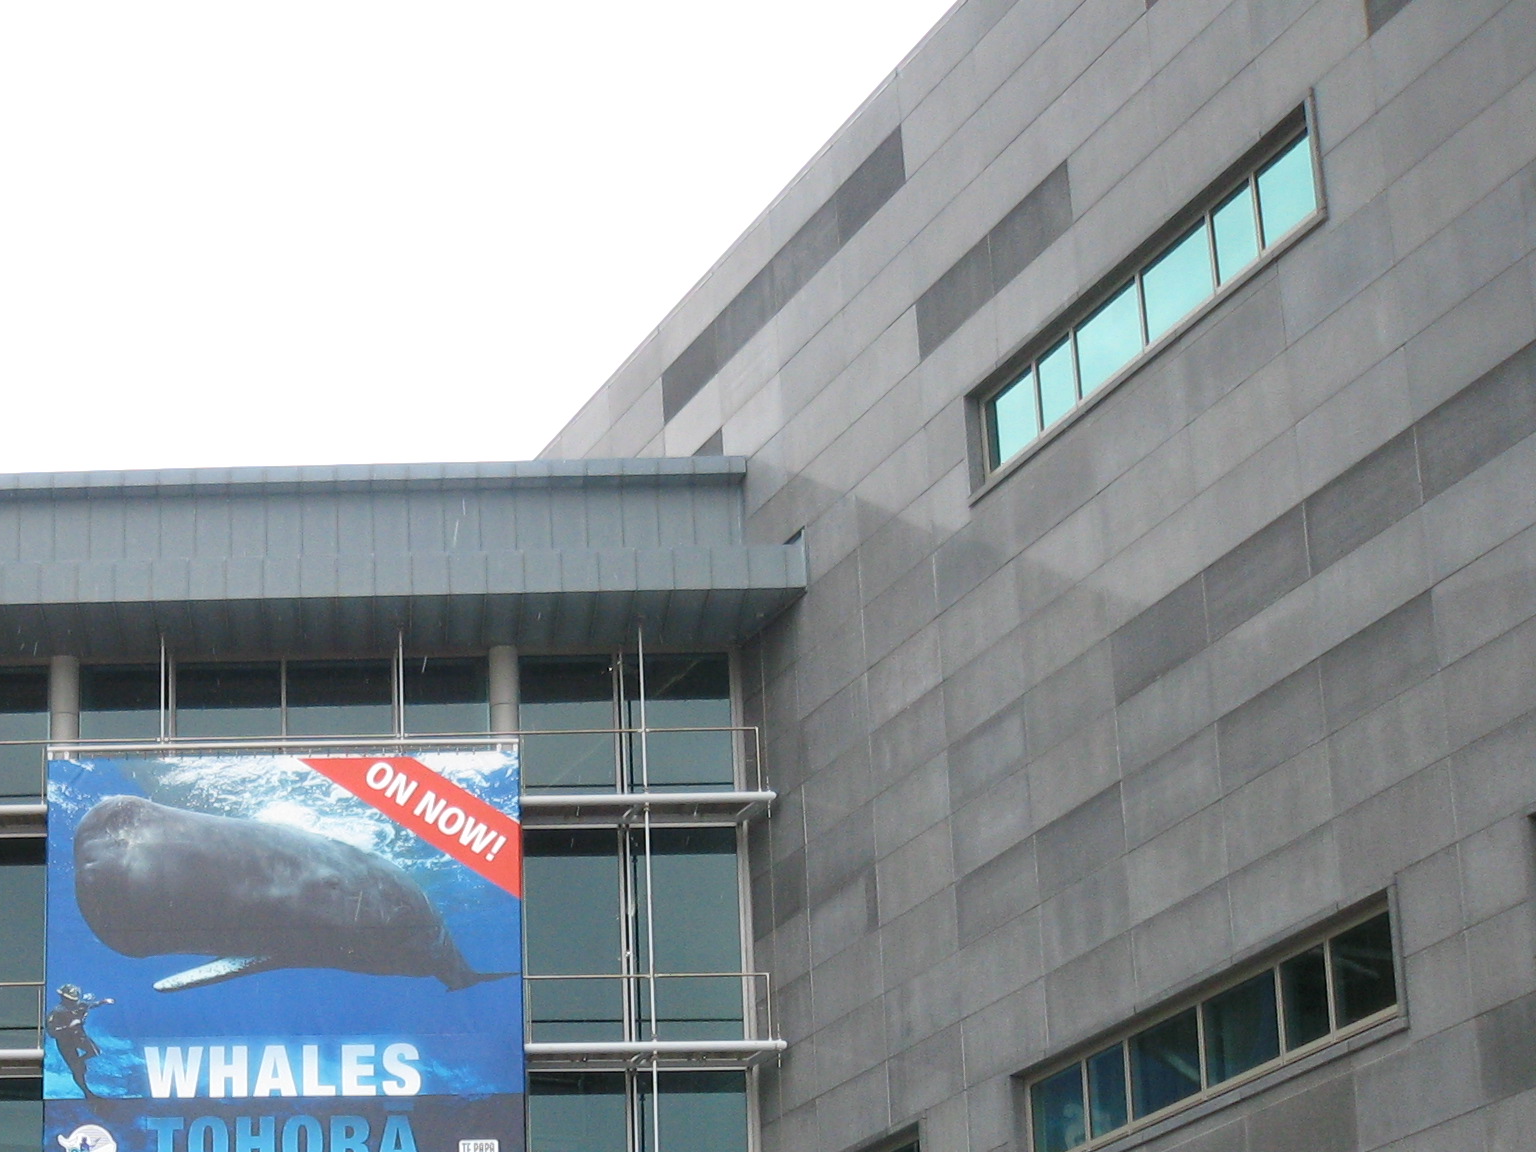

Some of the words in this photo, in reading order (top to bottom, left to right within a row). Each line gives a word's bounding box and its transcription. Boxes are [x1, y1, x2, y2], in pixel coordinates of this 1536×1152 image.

[365, 761, 418, 806] ON
[413, 789, 507, 862] NOW!
[143, 1042, 422, 1099] WHALES
